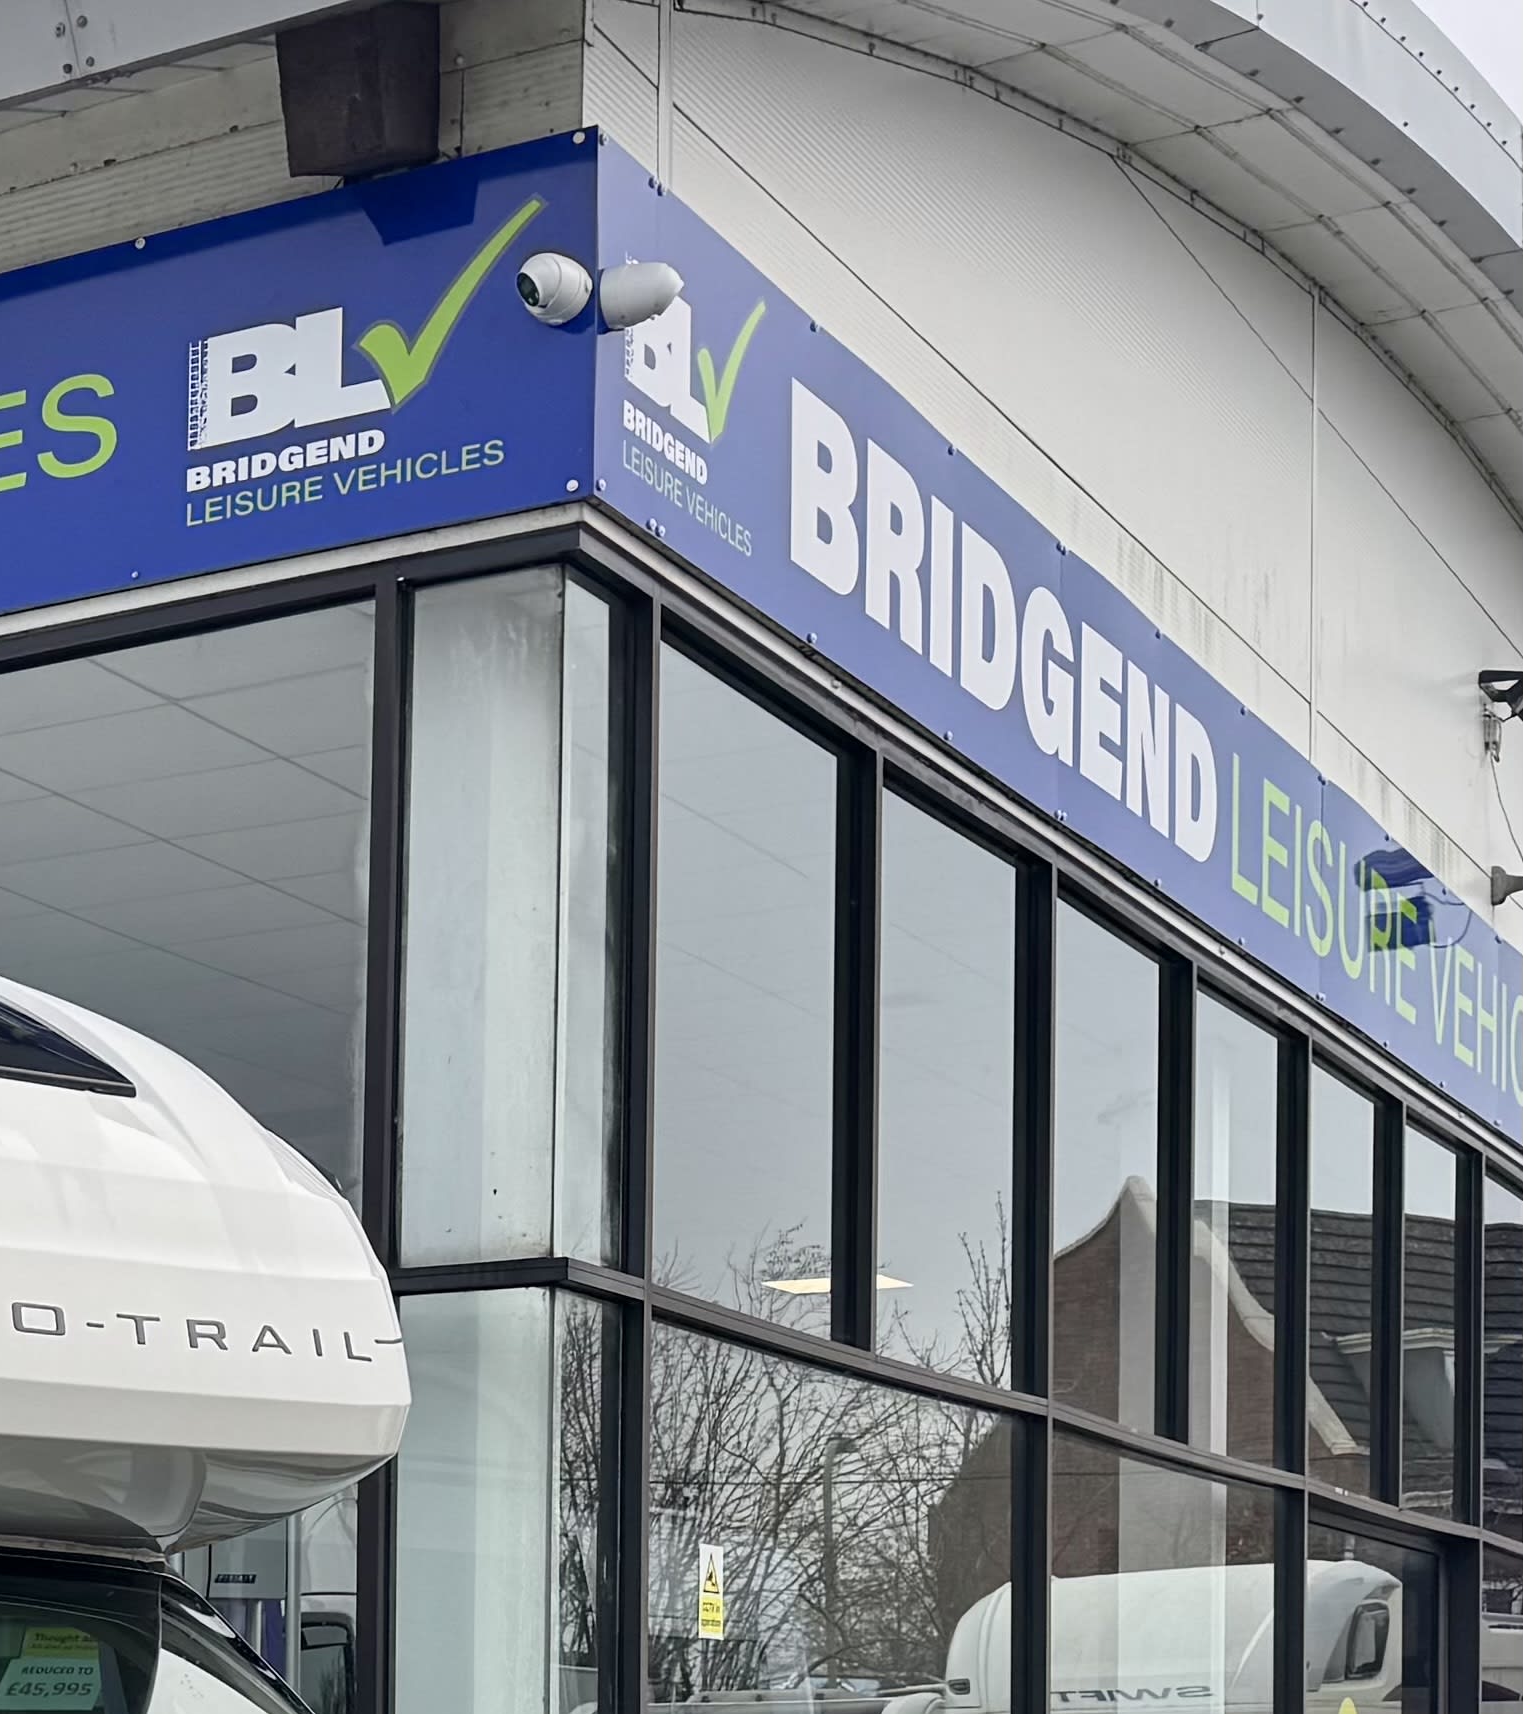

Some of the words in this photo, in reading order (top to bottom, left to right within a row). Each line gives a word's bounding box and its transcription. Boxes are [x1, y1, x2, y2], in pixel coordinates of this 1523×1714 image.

[186, 429, 386, 493] BRIDGEND
[186, 478, 324, 527] LEISURE
[333, 440, 505, 498] VEHICLES
[623, 399, 708, 486] BRIDGEND
[623, 440, 683, 508] LEISURE
[686, 486, 752, 557] VEHICLES
[790, 377, 1218, 864] BRIDGEND
[1231, 753, 1417, 1025] LEISURE
[6, 1681, 93, 1698] £45,995
[78, 1666, 94, 1675] TO
